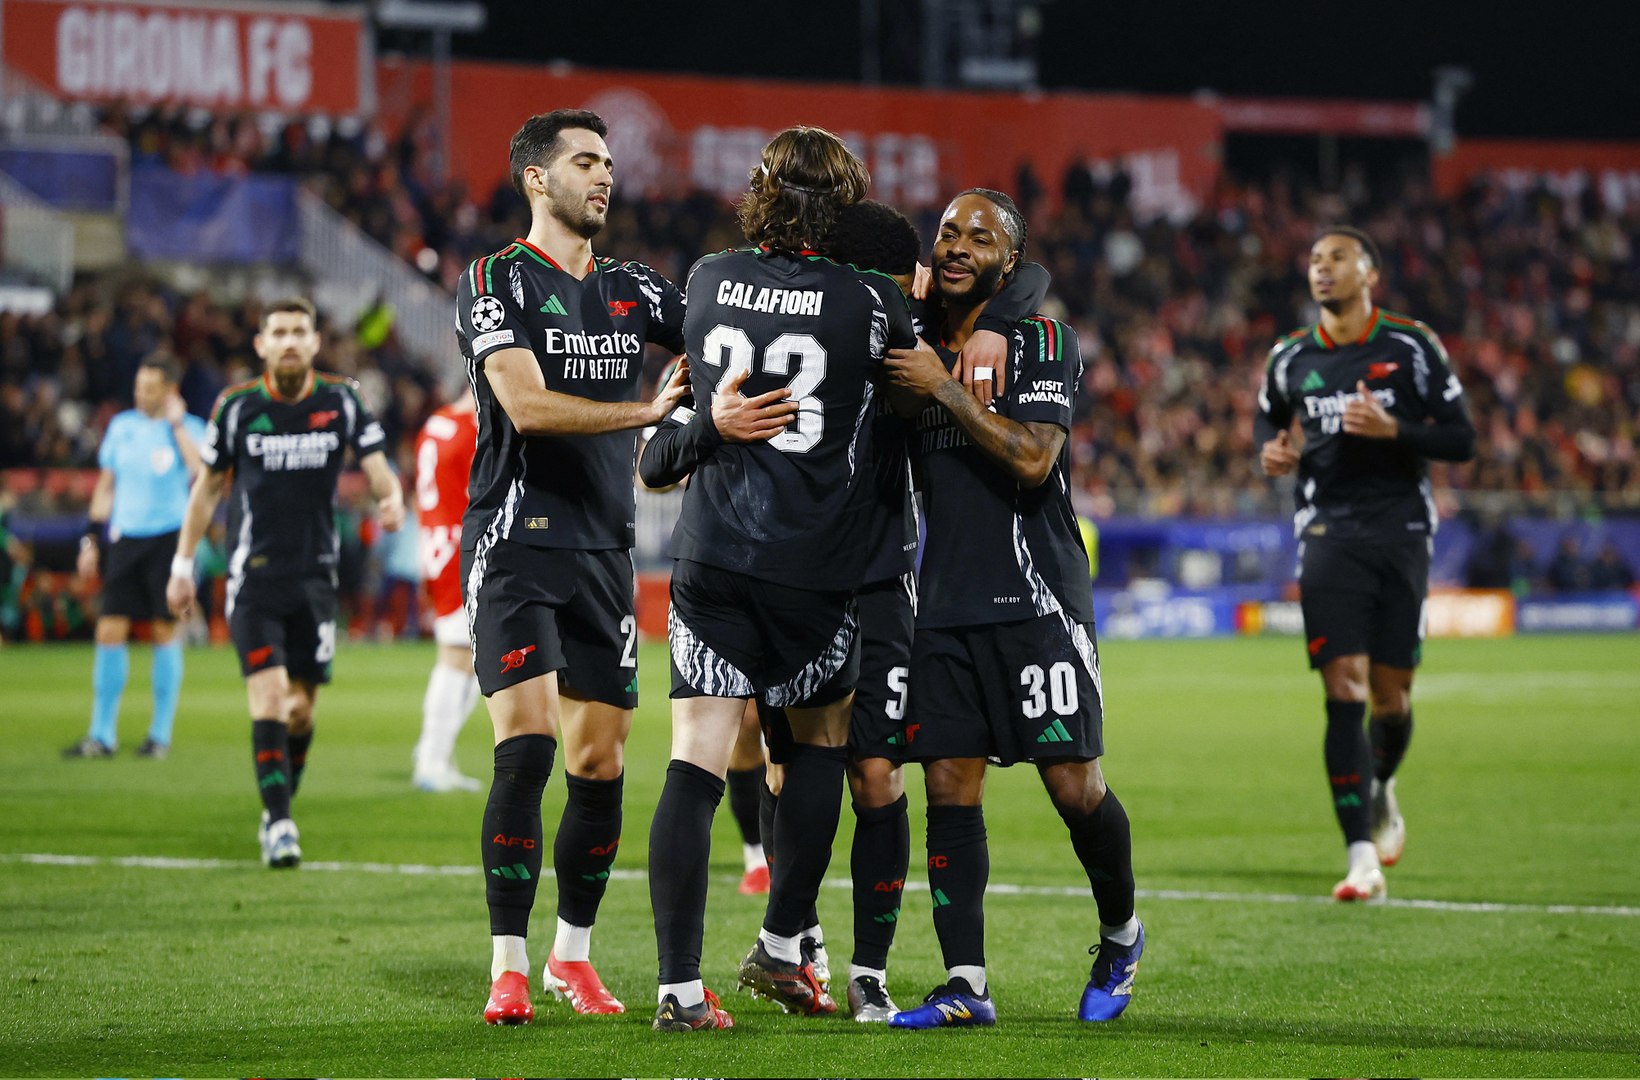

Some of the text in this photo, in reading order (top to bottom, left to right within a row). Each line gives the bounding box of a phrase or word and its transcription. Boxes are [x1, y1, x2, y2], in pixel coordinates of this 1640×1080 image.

[56, 8, 313, 106] GIRONA FC
[717, 280, 824, 316] CALAFIORI
[544, 328, 641, 355] Emirates
[564, 358, 628, 380] FLY BETTER
[1032, 380, 1064, 393] VISIT
[1019, 391, 1070, 408] RWANDA
[246, 432, 339, 457] Emirates
[620, 615, 637, 668] 2
[1020, 661, 1079, 719] 30
[493, 834, 535, 849] AFC
[590, 838, 621, 856] AF
[928, 855, 949, 869] FC
